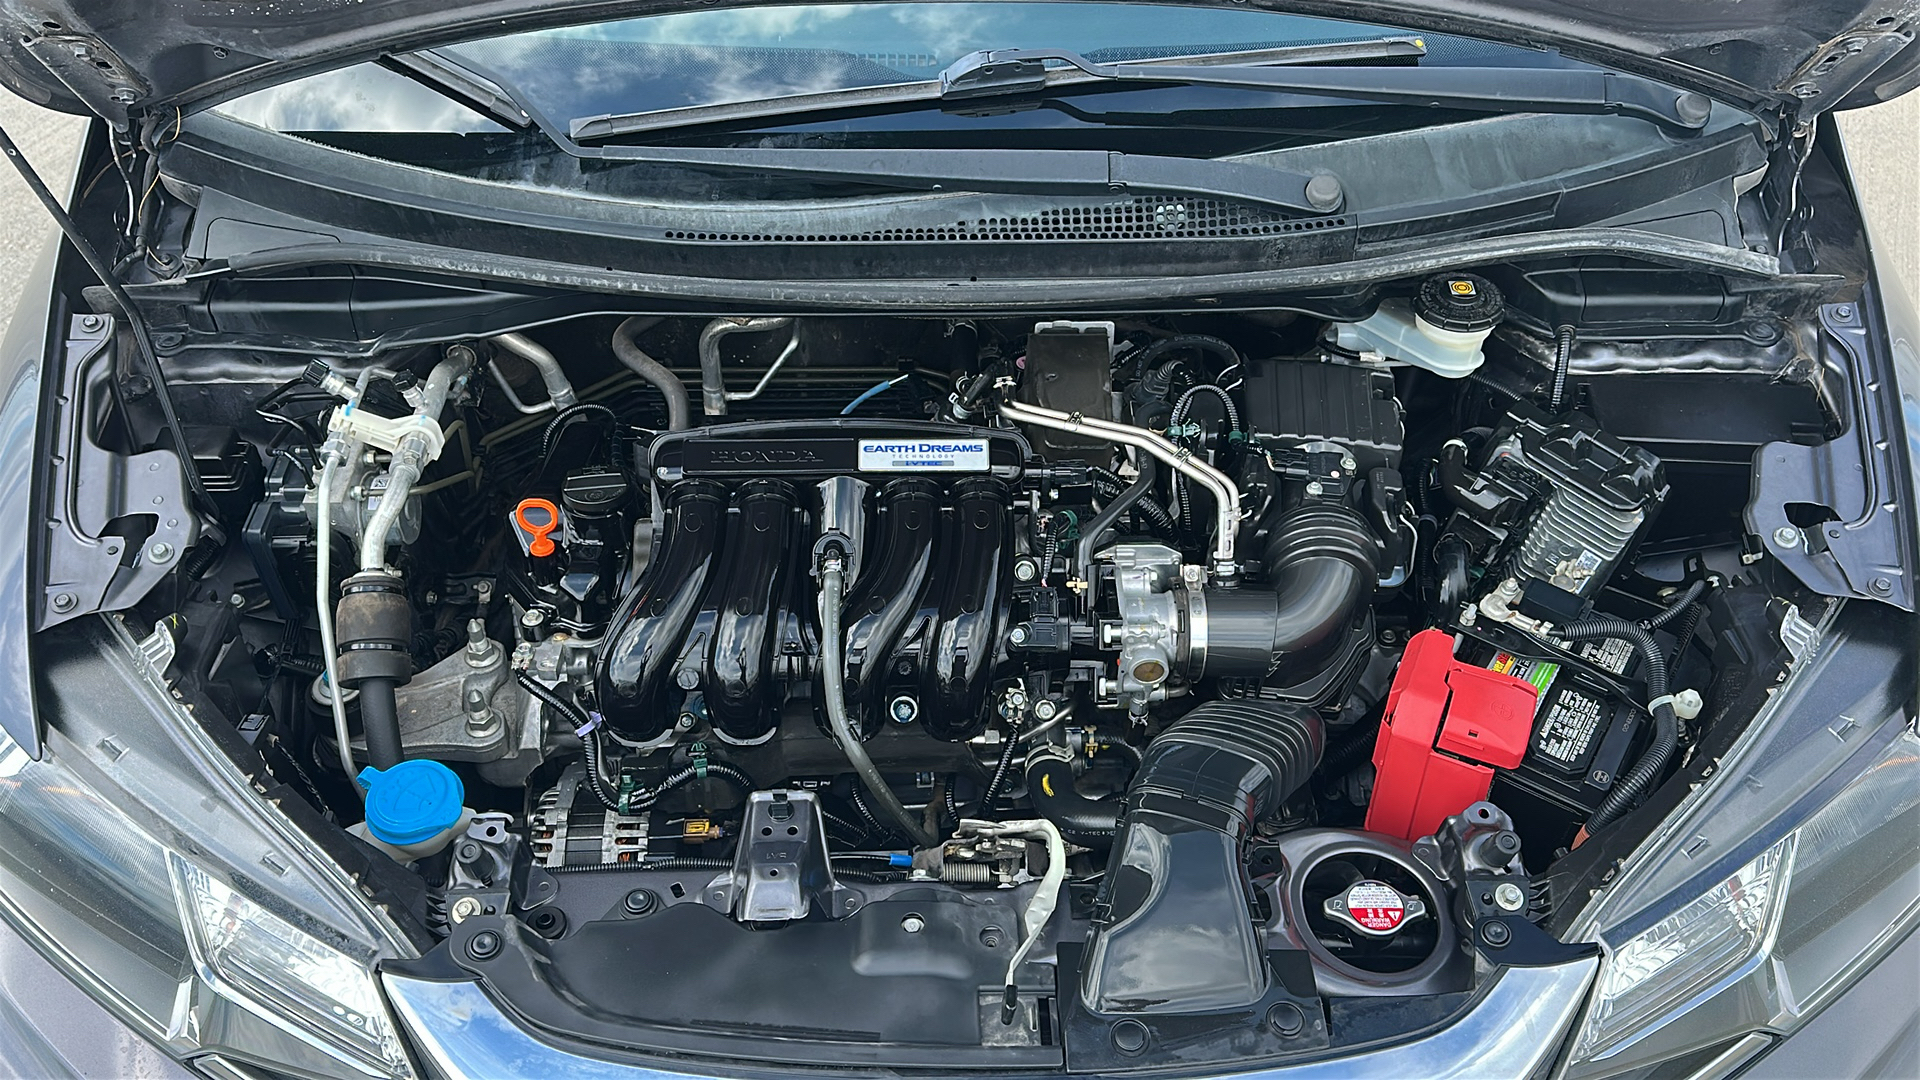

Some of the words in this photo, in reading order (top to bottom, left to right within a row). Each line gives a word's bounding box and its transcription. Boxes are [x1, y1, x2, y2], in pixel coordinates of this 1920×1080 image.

[863, 444, 916, 453] EARTH
[918, 443, 984, 453] DREAMS
[710, 450, 824, 463] HONDA
